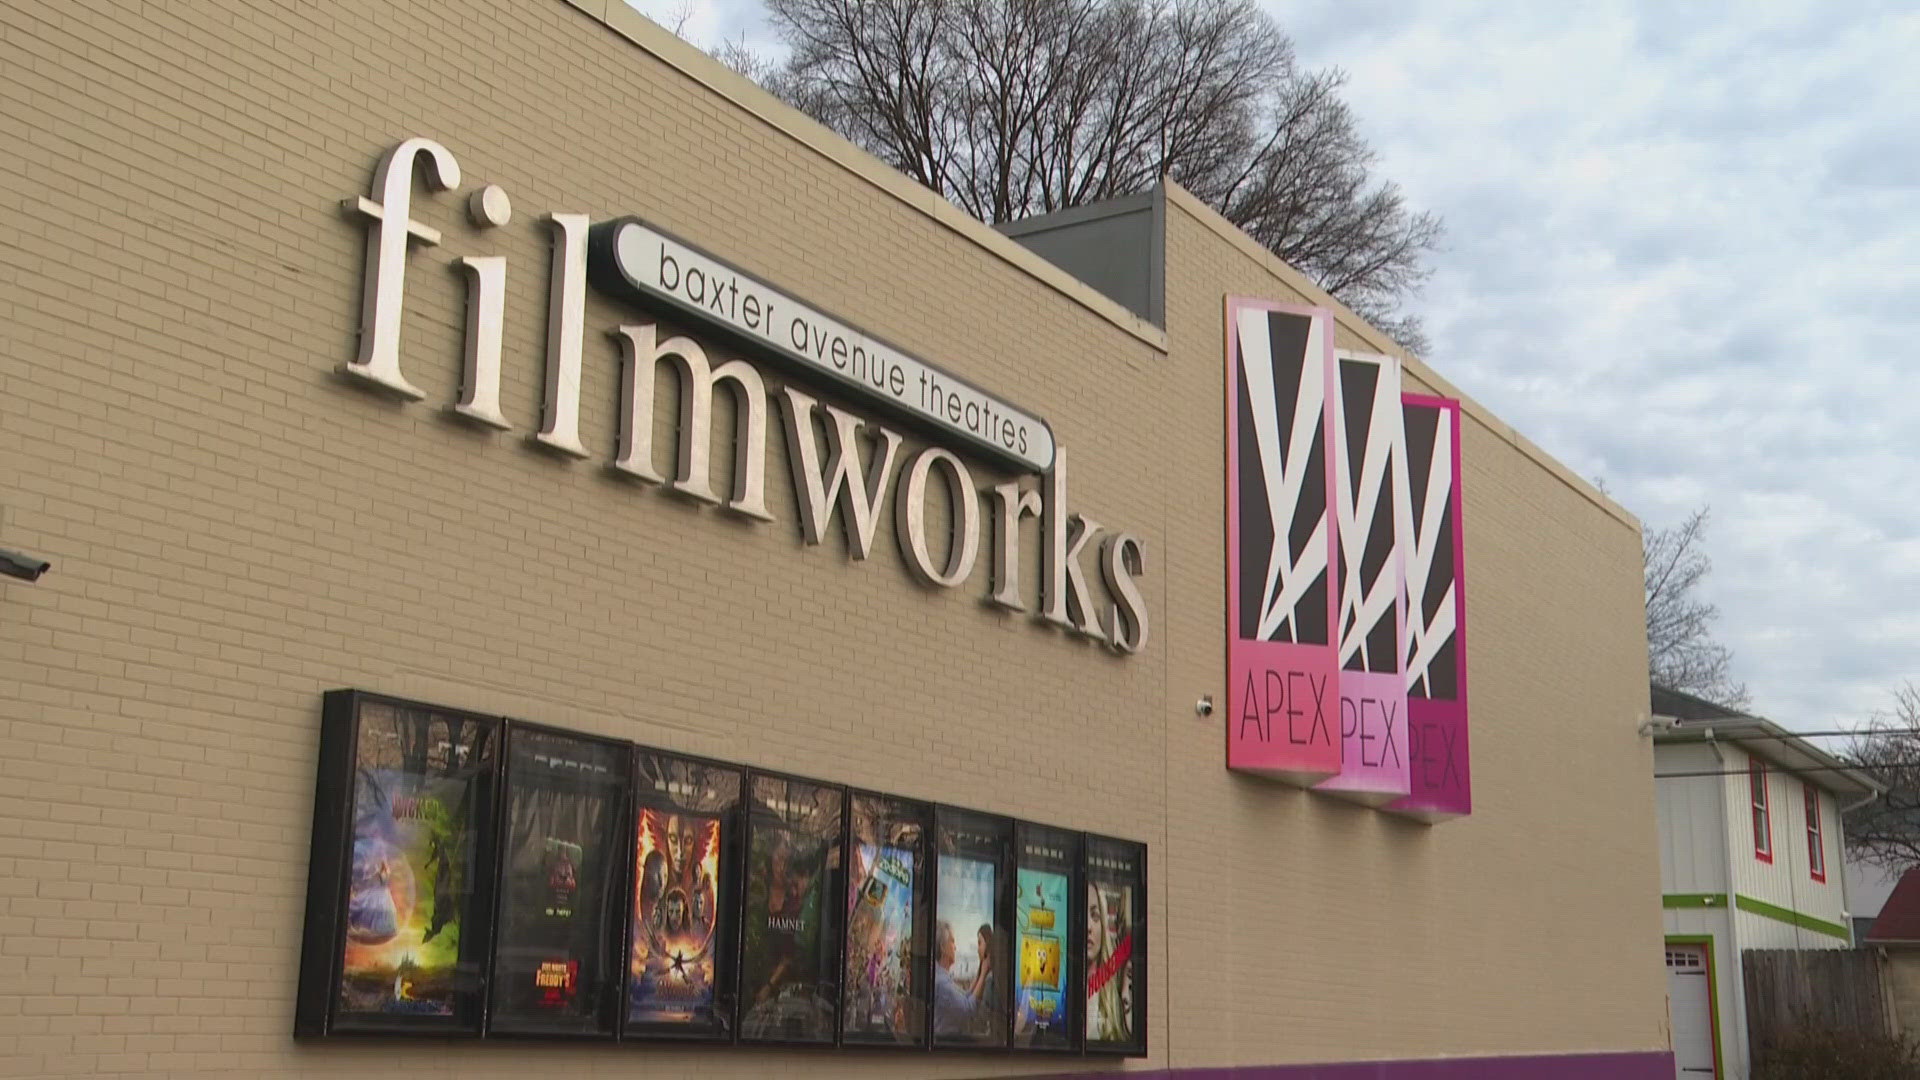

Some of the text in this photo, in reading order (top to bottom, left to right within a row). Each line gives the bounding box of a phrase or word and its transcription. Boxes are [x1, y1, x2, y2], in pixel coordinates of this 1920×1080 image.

[338, 136, 1150, 656] filmworks
[659, 241, 1028, 456] baxter avenue theatres
[1239, 668, 1331, 747] APEX
[767, 915, 806, 932] HAMNET
